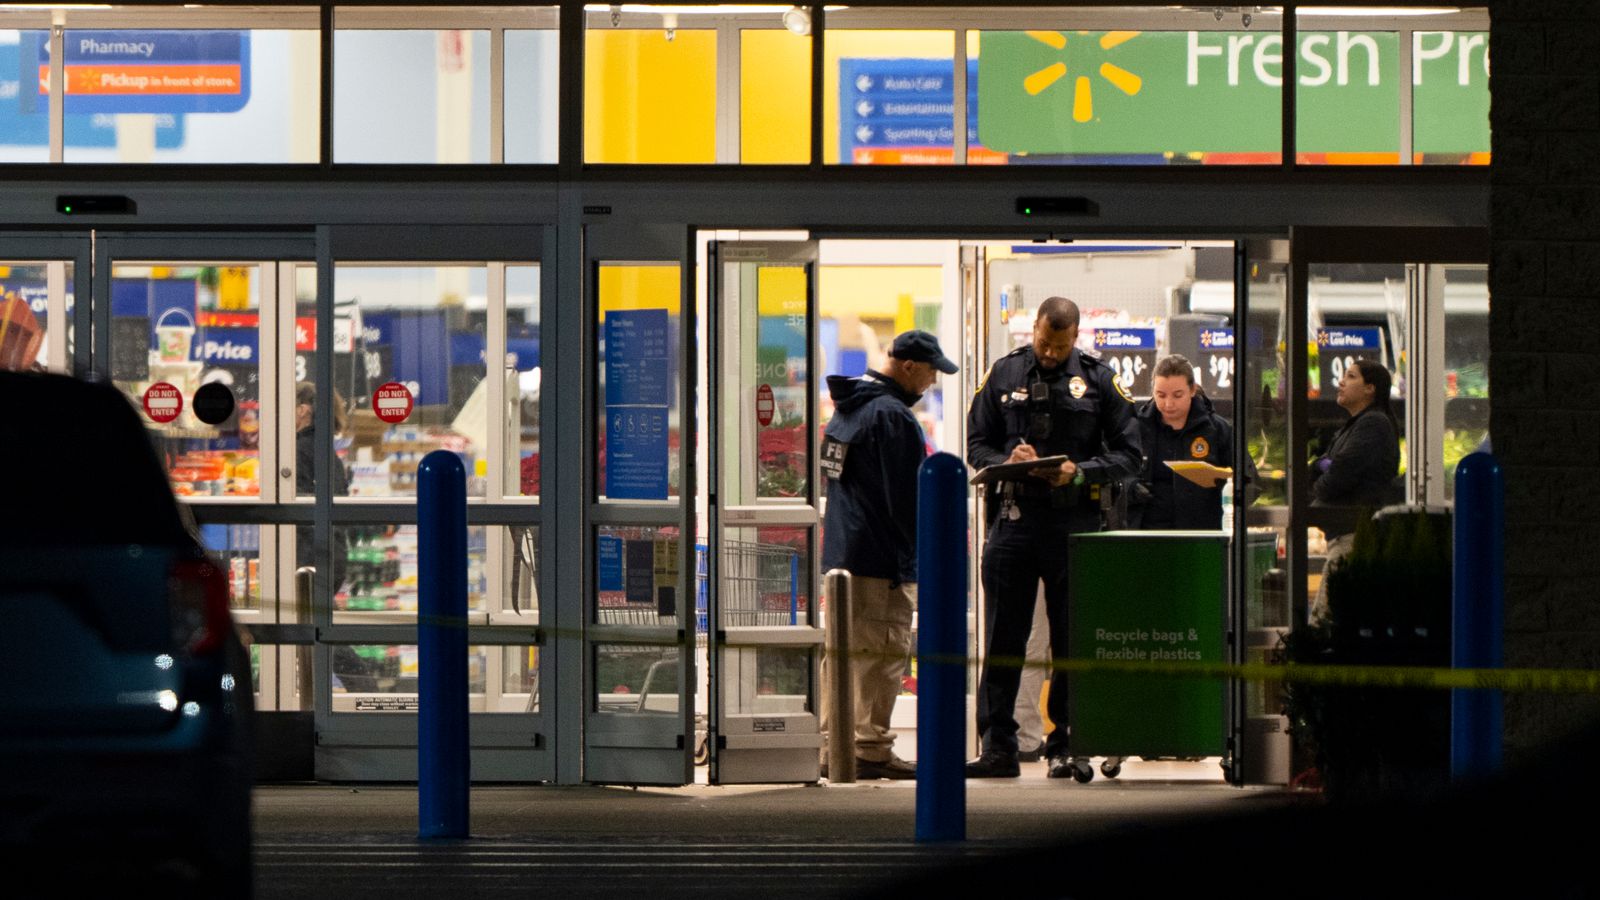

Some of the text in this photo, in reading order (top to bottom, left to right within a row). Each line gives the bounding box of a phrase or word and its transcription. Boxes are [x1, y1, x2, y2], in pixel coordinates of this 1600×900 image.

[80, 39, 155, 57] Pharmacy
[1187, 31, 1491, 87] Fresh Pr
[101, 73, 148, 89] Pickup
[151, 76, 161, 87] in
[163, 75, 190, 87] front
[192, 75, 205, 87] of
[203, 336, 253, 361] Price
[149, 390, 177, 398] DO NOT
[379, 390, 407, 398] DO NOT
[151, 408, 175, 416] ENTER
[381, 408, 405, 417] ENTER
[1095, 628, 1198, 645] Recycle bags &
[1096, 647, 1201, 663] flexible plastics
